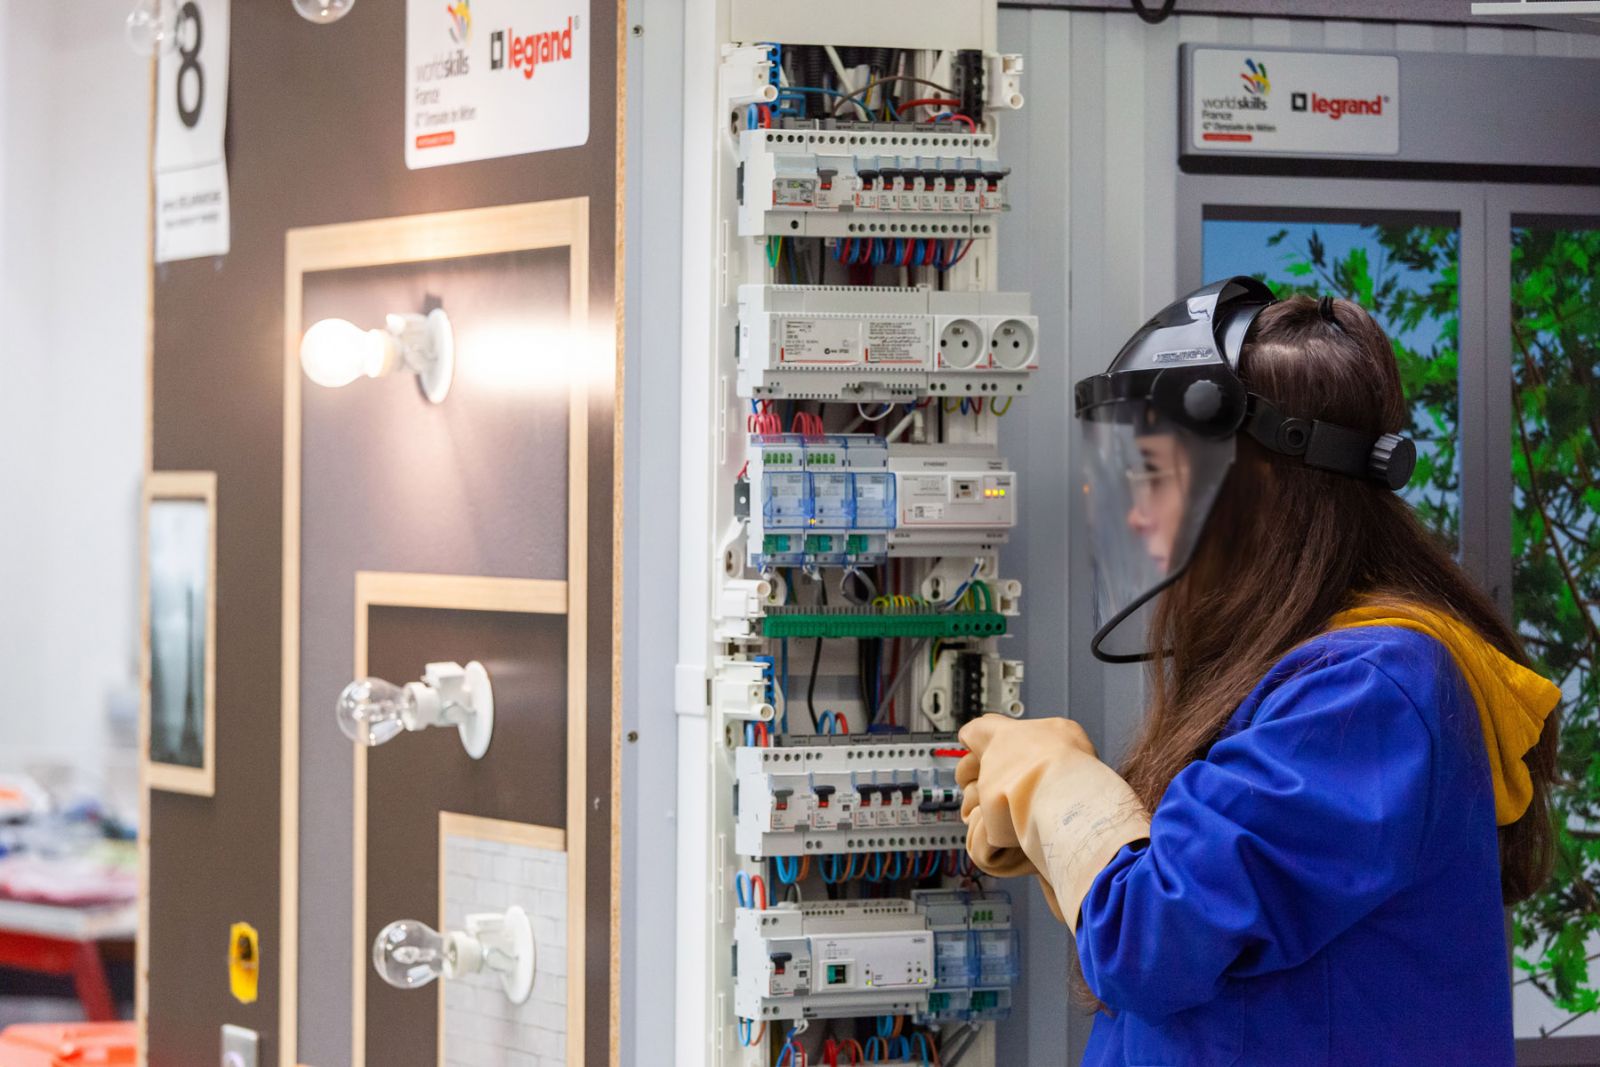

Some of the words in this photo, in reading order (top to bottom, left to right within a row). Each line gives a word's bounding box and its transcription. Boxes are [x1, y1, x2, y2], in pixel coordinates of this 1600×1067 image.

[508, 16, 572, 79] legrand
[175, 1, 205, 128] 8
[1202, 96, 1268, 111] worldskills
[1202, 110, 1232, 121] France
[1312, 92, 1382, 119] legrand
